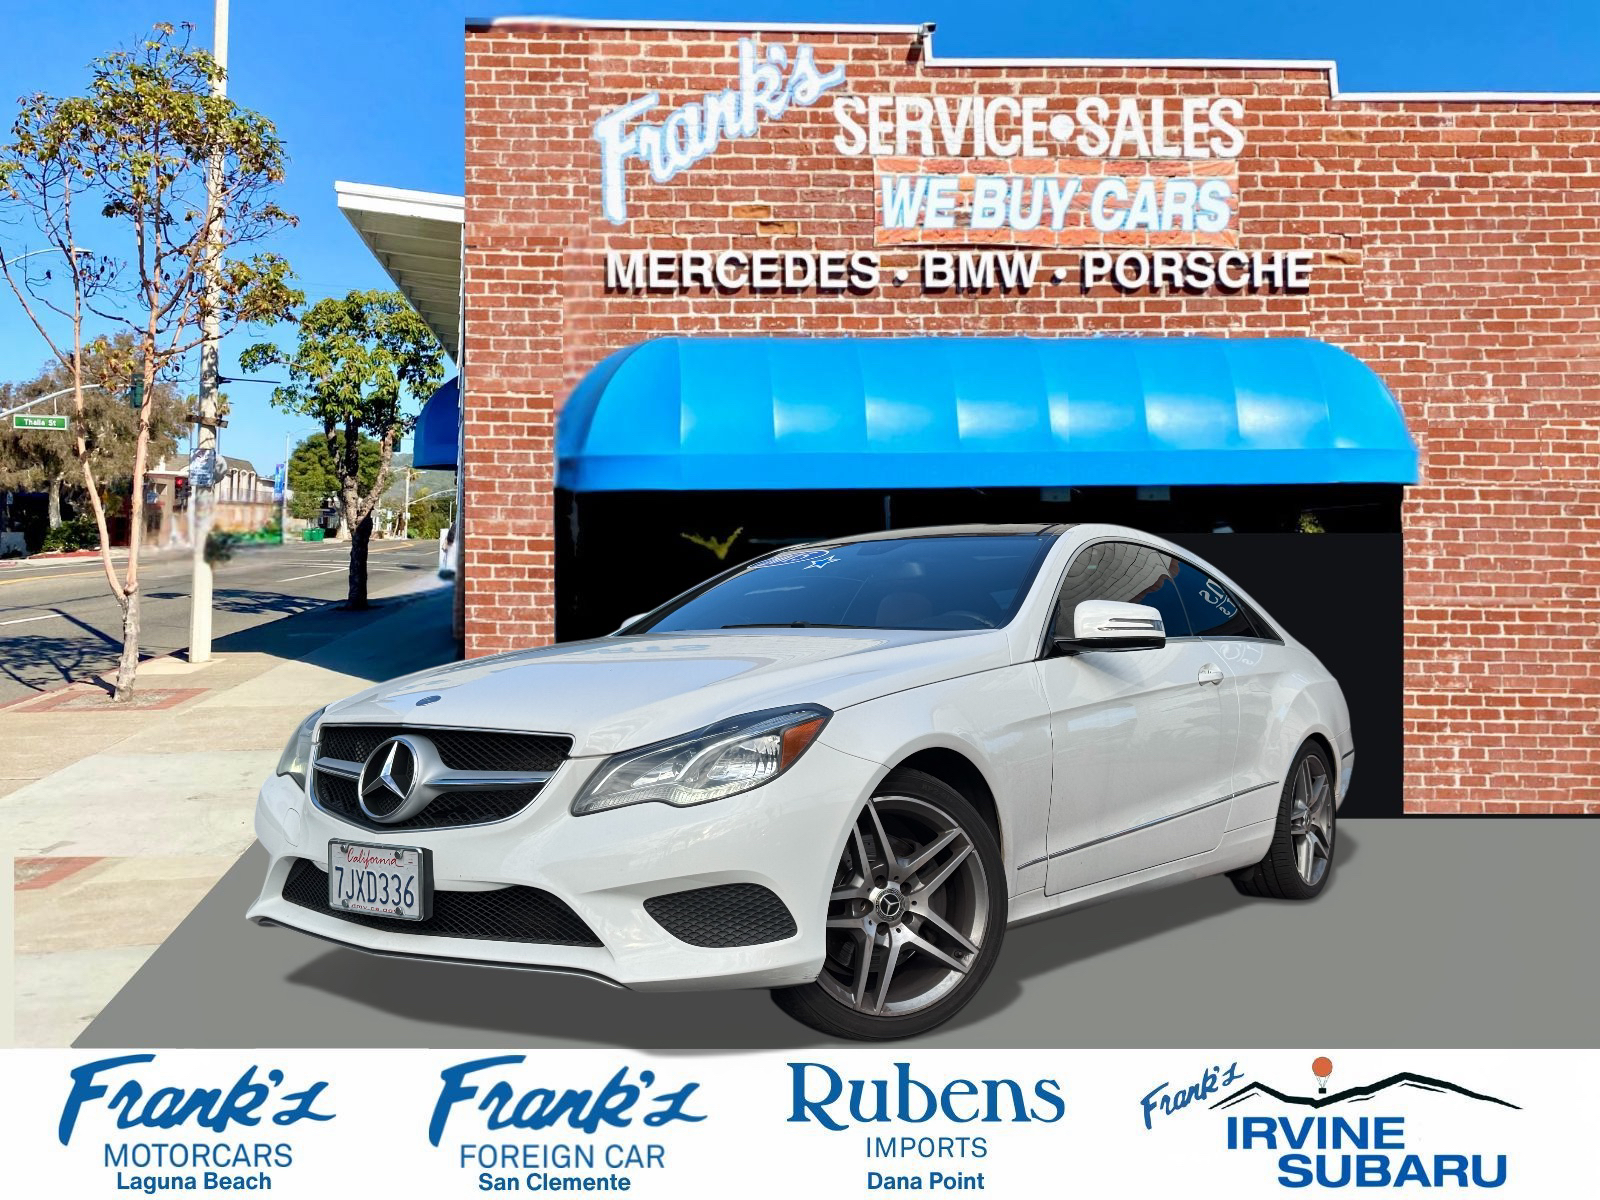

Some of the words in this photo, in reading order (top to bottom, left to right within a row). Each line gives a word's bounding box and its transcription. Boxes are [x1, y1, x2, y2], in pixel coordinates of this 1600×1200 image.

[593, 37, 846, 225] Frank's
[833, 96, 1048, 157] SERVICE
[1075, 97, 1245, 158] SALES
[880, 174, 960, 229] WE
[970, 176, 1082, 231] BUY
[1089, 177, 1233, 233] CARS
[606, 250, 881, 290] MERCEDES
[924, 250, 1040, 289] BMW
[1083, 250, 1314, 289] PORSCHE
[24, 418, 45, 426] Thalia
[48, 419, 57, 427] St
[346, 847, 404, 869] California
[335, 866, 415, 908] 7JXD336
